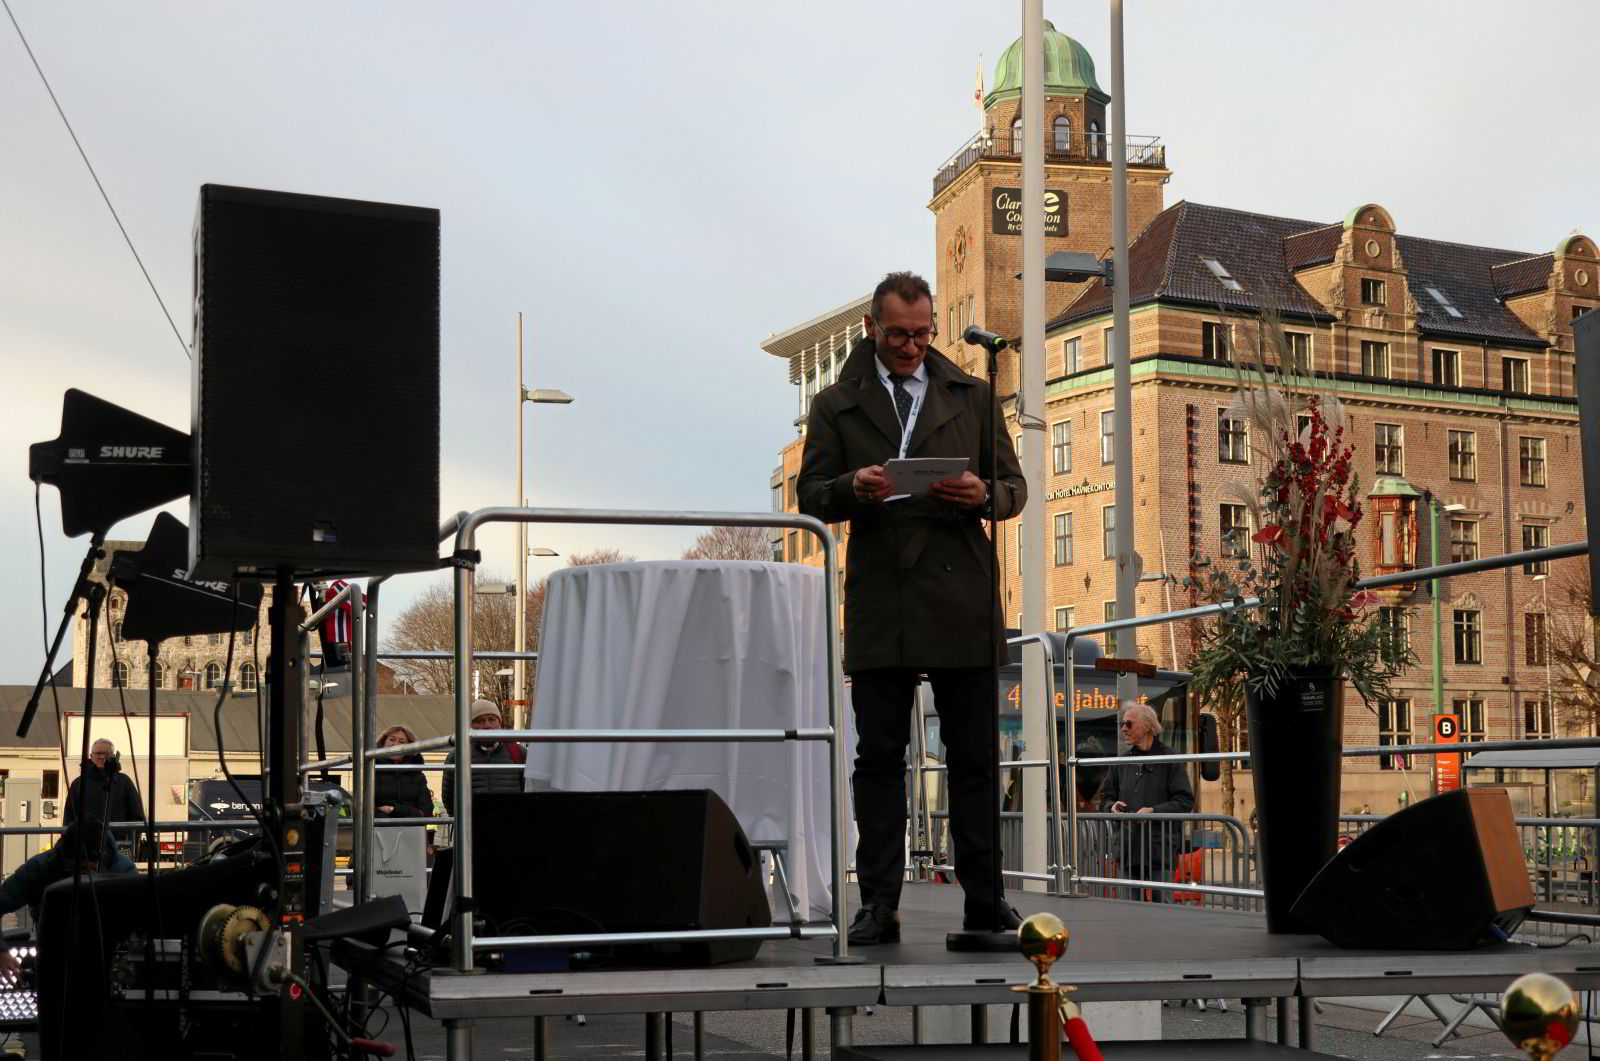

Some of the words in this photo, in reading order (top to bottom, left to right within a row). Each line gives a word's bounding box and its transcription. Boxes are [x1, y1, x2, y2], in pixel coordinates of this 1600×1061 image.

[996, 193, 1021, 210] Clar
[1006, 210, 1061, 224] Coion
[1007, 223, 1015, 231] By
[99, 446, 162, 459] SHURE
[1071, 482, 1116, 496] HAVNEKONTOR
[171, 568, 229, 593] SRE
[1442, 721, 1452, 735] B
